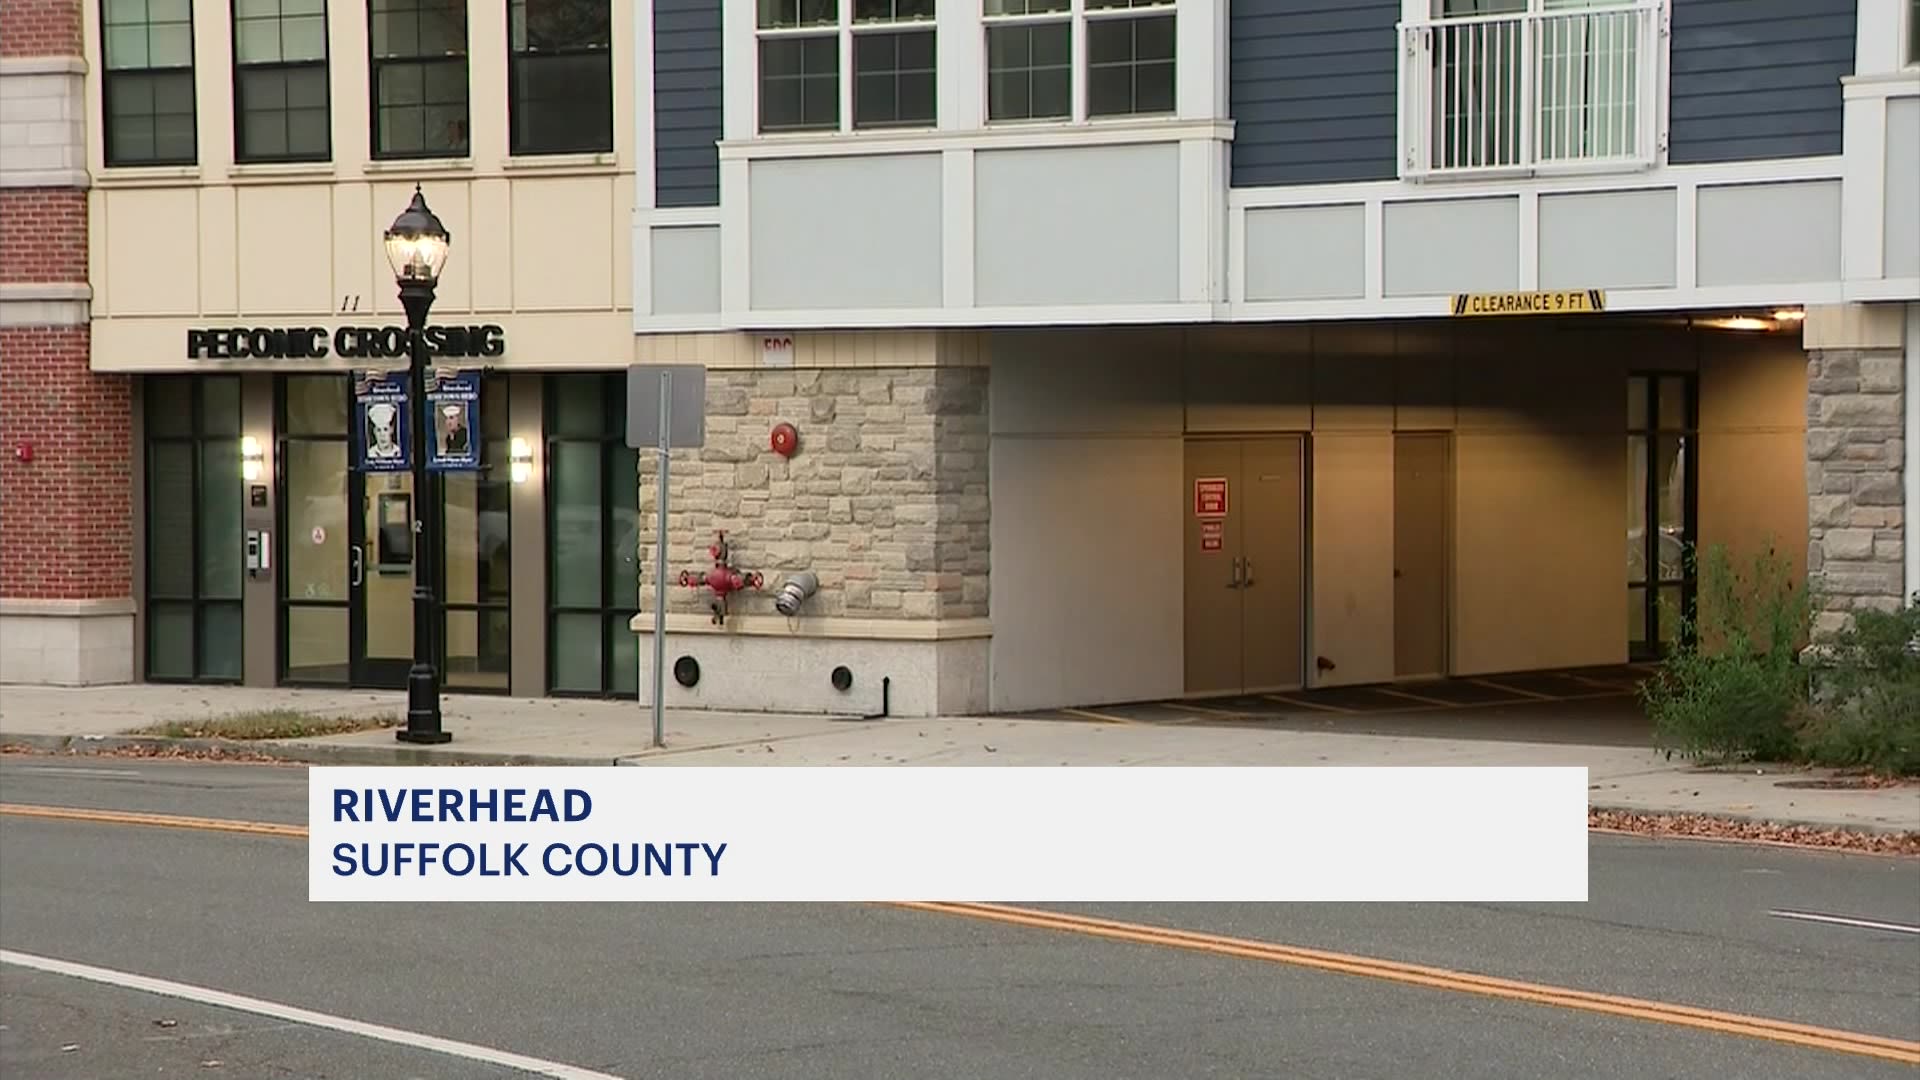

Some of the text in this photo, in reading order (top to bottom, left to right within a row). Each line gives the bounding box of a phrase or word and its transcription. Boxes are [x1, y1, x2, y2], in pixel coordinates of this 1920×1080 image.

[341, 295, 360, 311] 11
[1473, 293, 1584, 312] CLEARANCE 9 FT
[187, 328, 329, 359] PECONIC
